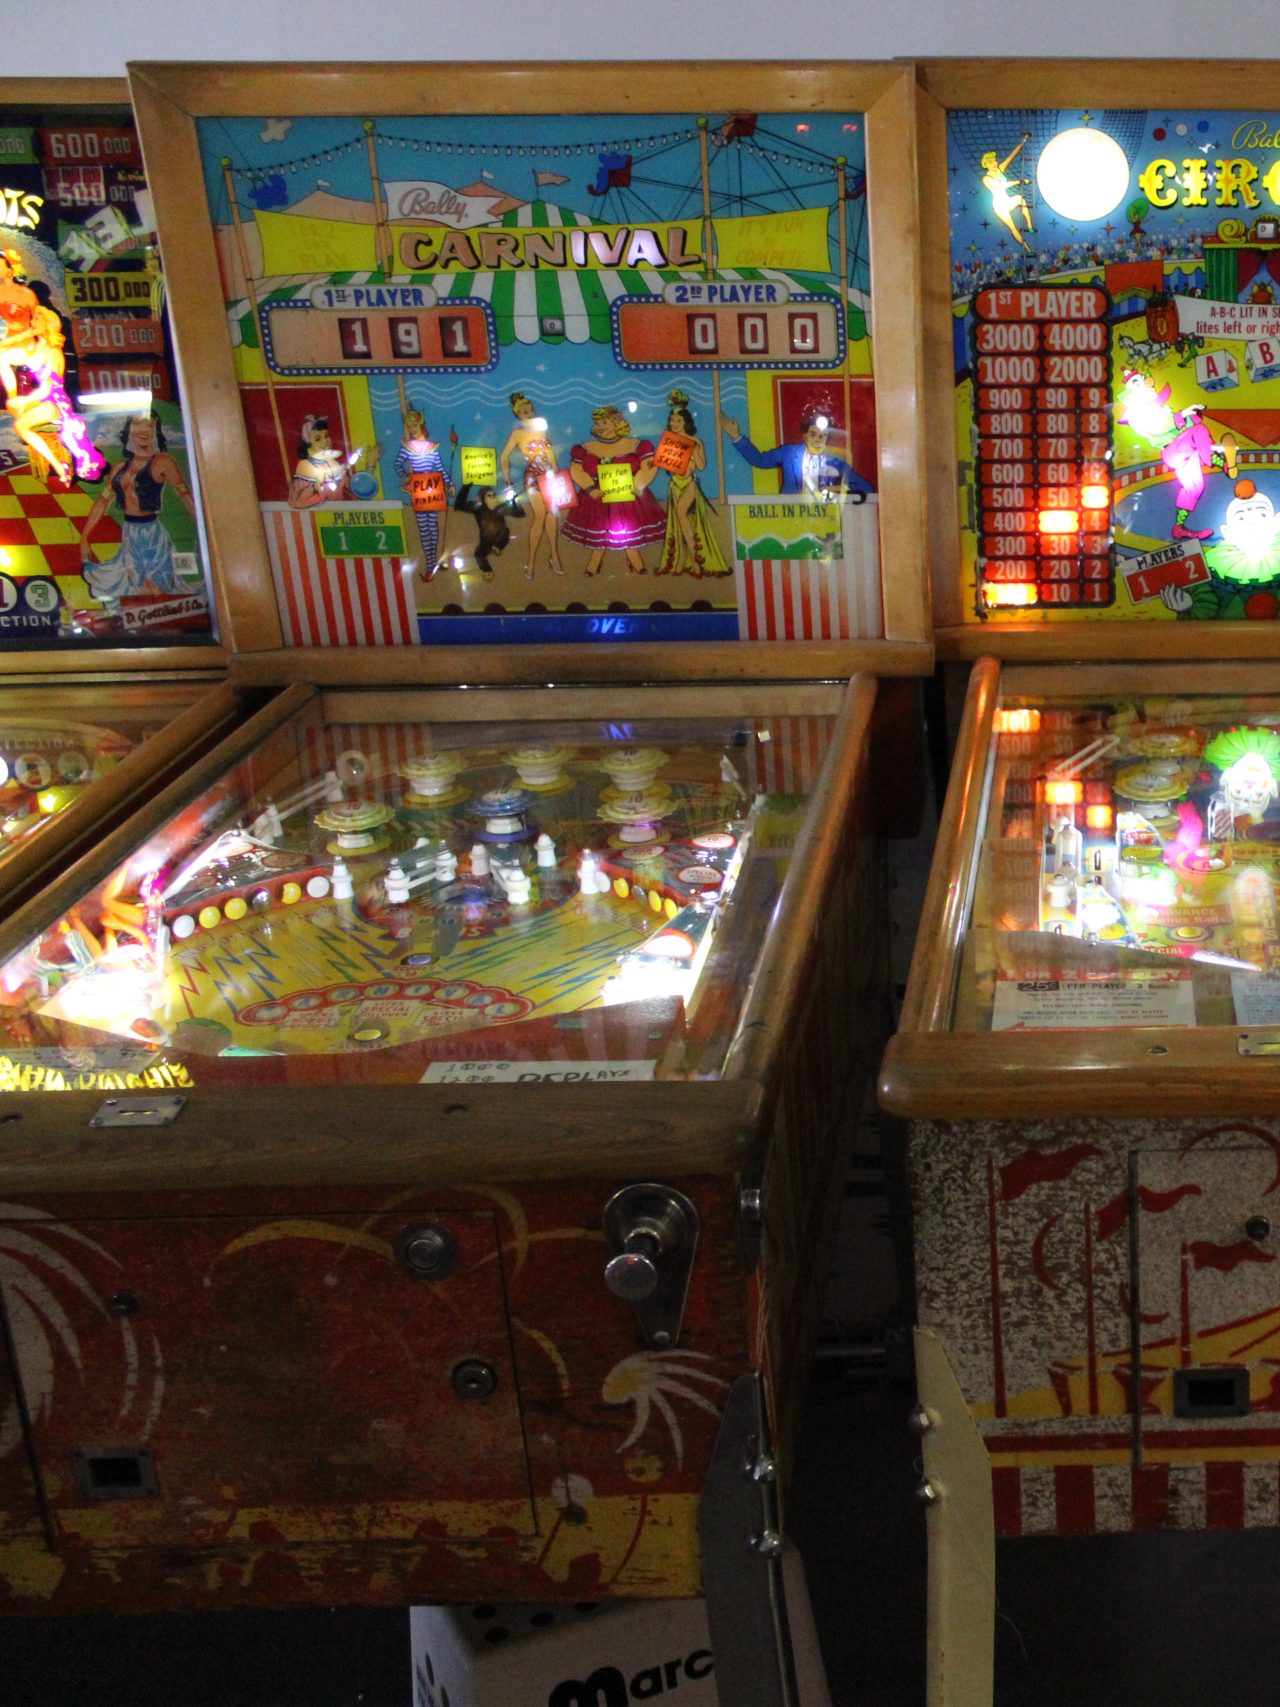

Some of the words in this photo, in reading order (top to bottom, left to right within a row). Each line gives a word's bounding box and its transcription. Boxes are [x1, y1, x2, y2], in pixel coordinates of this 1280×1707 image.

[399, 187, 468, 223] Bally
[400, 227, 703, 270] CARNIVAL
[354, 288, 425, 307] PLAYER
[708, 284, 777, 303] PLAYER
[988, 291, 1013, 318] 1ST
[1020, 291, 1098, 318] PLAYER
[1210, 307, 1236, 318] A-B-C
[1239, 306, 1254, 317] LIT
[1258, 307, 1268, 317] IN
[1223, 321, 1242, 333] left
[1246, 325, 1256, 333] or
[982, 324, 1035, 350] 3000
[1049, 324, 1102, 350] 4000
[984, 357, 1035, 384] 1000
[1049, 356, 1103, 383] 2000
[1206, 355, 1219, 379] A
[1258, 342, 1274, 365] B
[989, 388, 1023, 409] 900
[1045, 388, 1068, 409] 90
[1089, 388, 1100, 409] 9
[990, 413, 1023, 434] 800
[1047, 413, 1068, 434] 80
[1089, 413, 1100, 434] 8
[663, 436, 692, 451] SHOW
[663, 447, 685, 459] YOUR
[992, 438, 1024, 459] 700
[1048, 438, 1068, 459] 70
[657, 454, 685, 469] SKILL
[992, 463, 1024, 483] 600
[1047, 463, 1069, 483] 60
[413, 477, 441, 492] PLAY
[603, 484, 633, 496] compete
[992, 487, 1025, 507] 500
[1047, 487, 1069, 507] 50
[332, 511, 385, 527] PLAYERS
[749, 506, 777, 519] BALL
[782, 506, 795, 518] IN
[799, 505, 828, 518] PLAY
[994, 511, 1026, 531] 400
[995, 536, 1027, 555] 300
[1050, 536, 1071, 555] 30
[1091, 536, 1100, 554] 3
[1136, 545, 1185, 570] PLAYERS
[995, 561, 1027, 579] 200
[1050, 560, 1071, 579] 20
[1091, 560, 1101, 578] 2
[1052, 585, 1071, 602] 10
